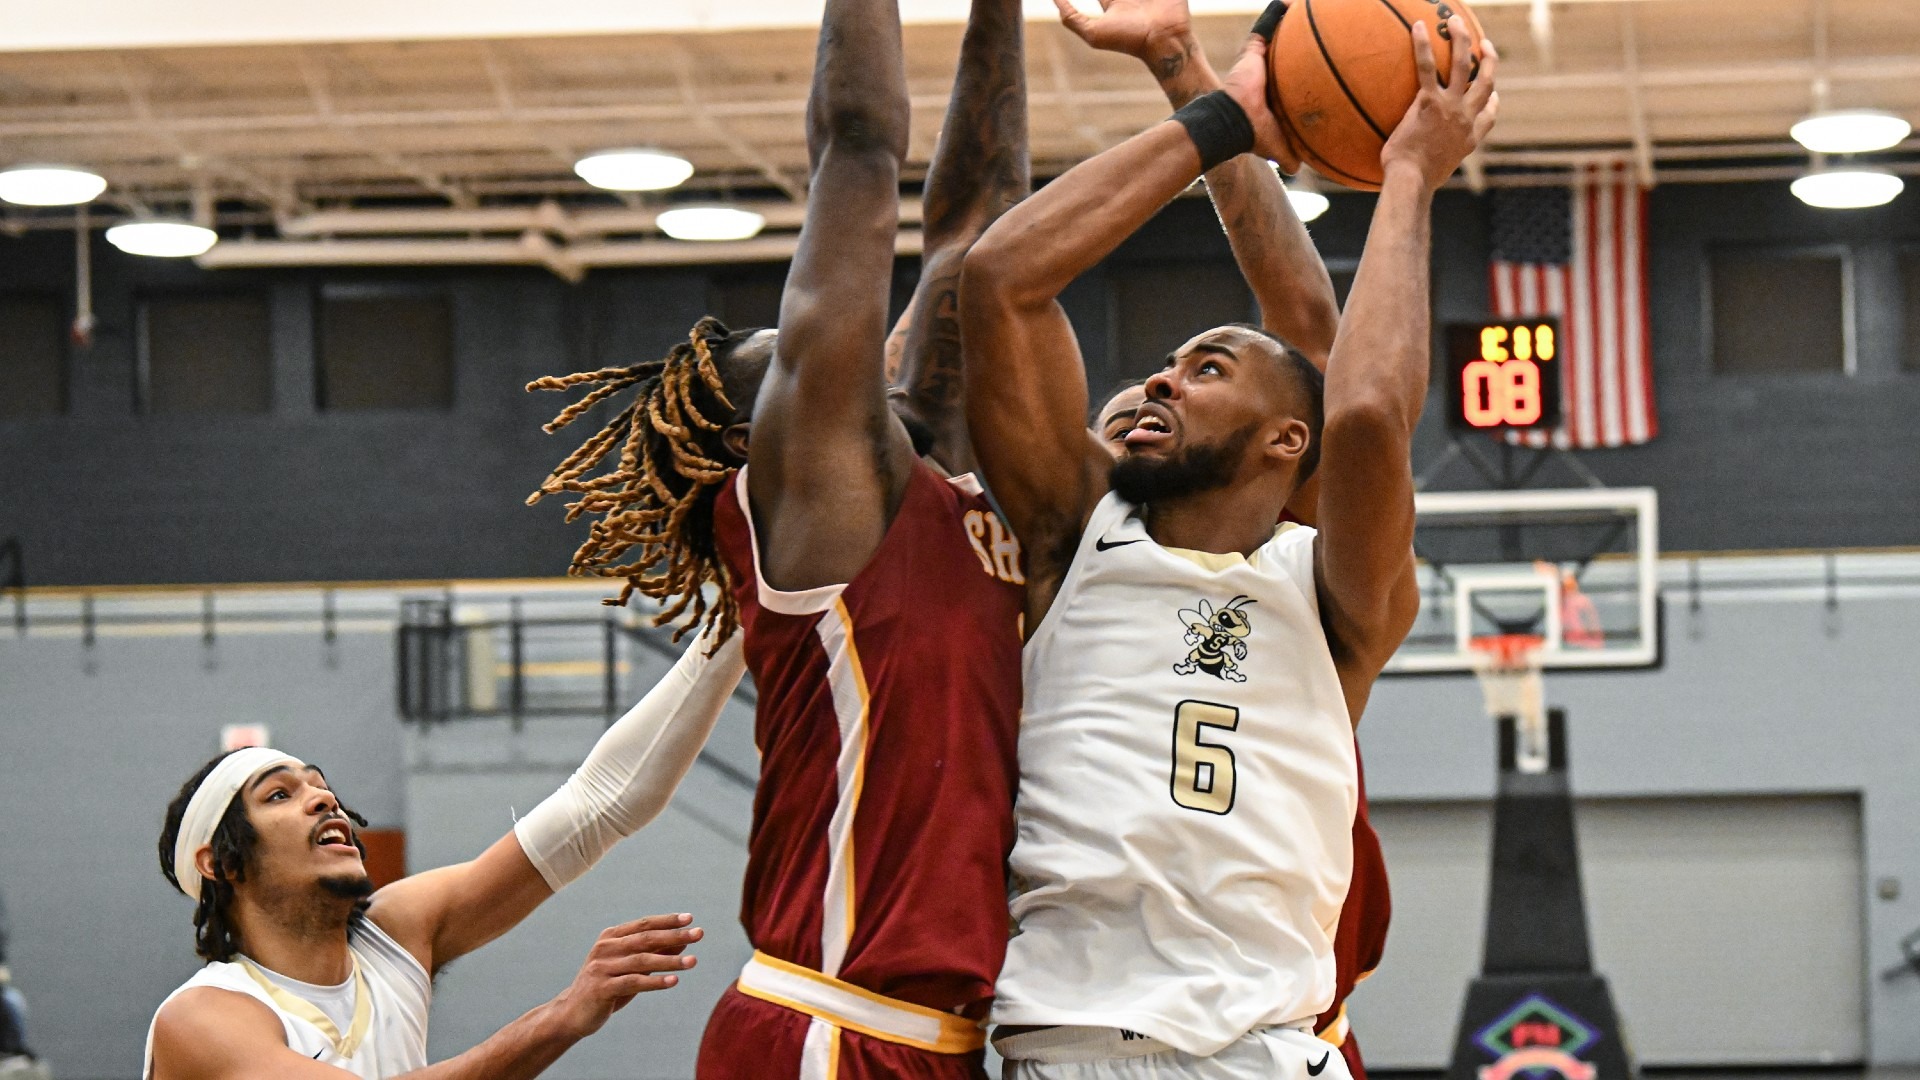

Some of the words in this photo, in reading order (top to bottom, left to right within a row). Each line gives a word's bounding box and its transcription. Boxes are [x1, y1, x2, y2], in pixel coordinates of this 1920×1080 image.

[1462, 360, 1541, 427] 08
[962, 509, 1026, 585] SH
[1209, 636, 1227, 650] S
[1170, 699, 1239, 815] 6
[1119, 1028, 1152, 1041] WV
